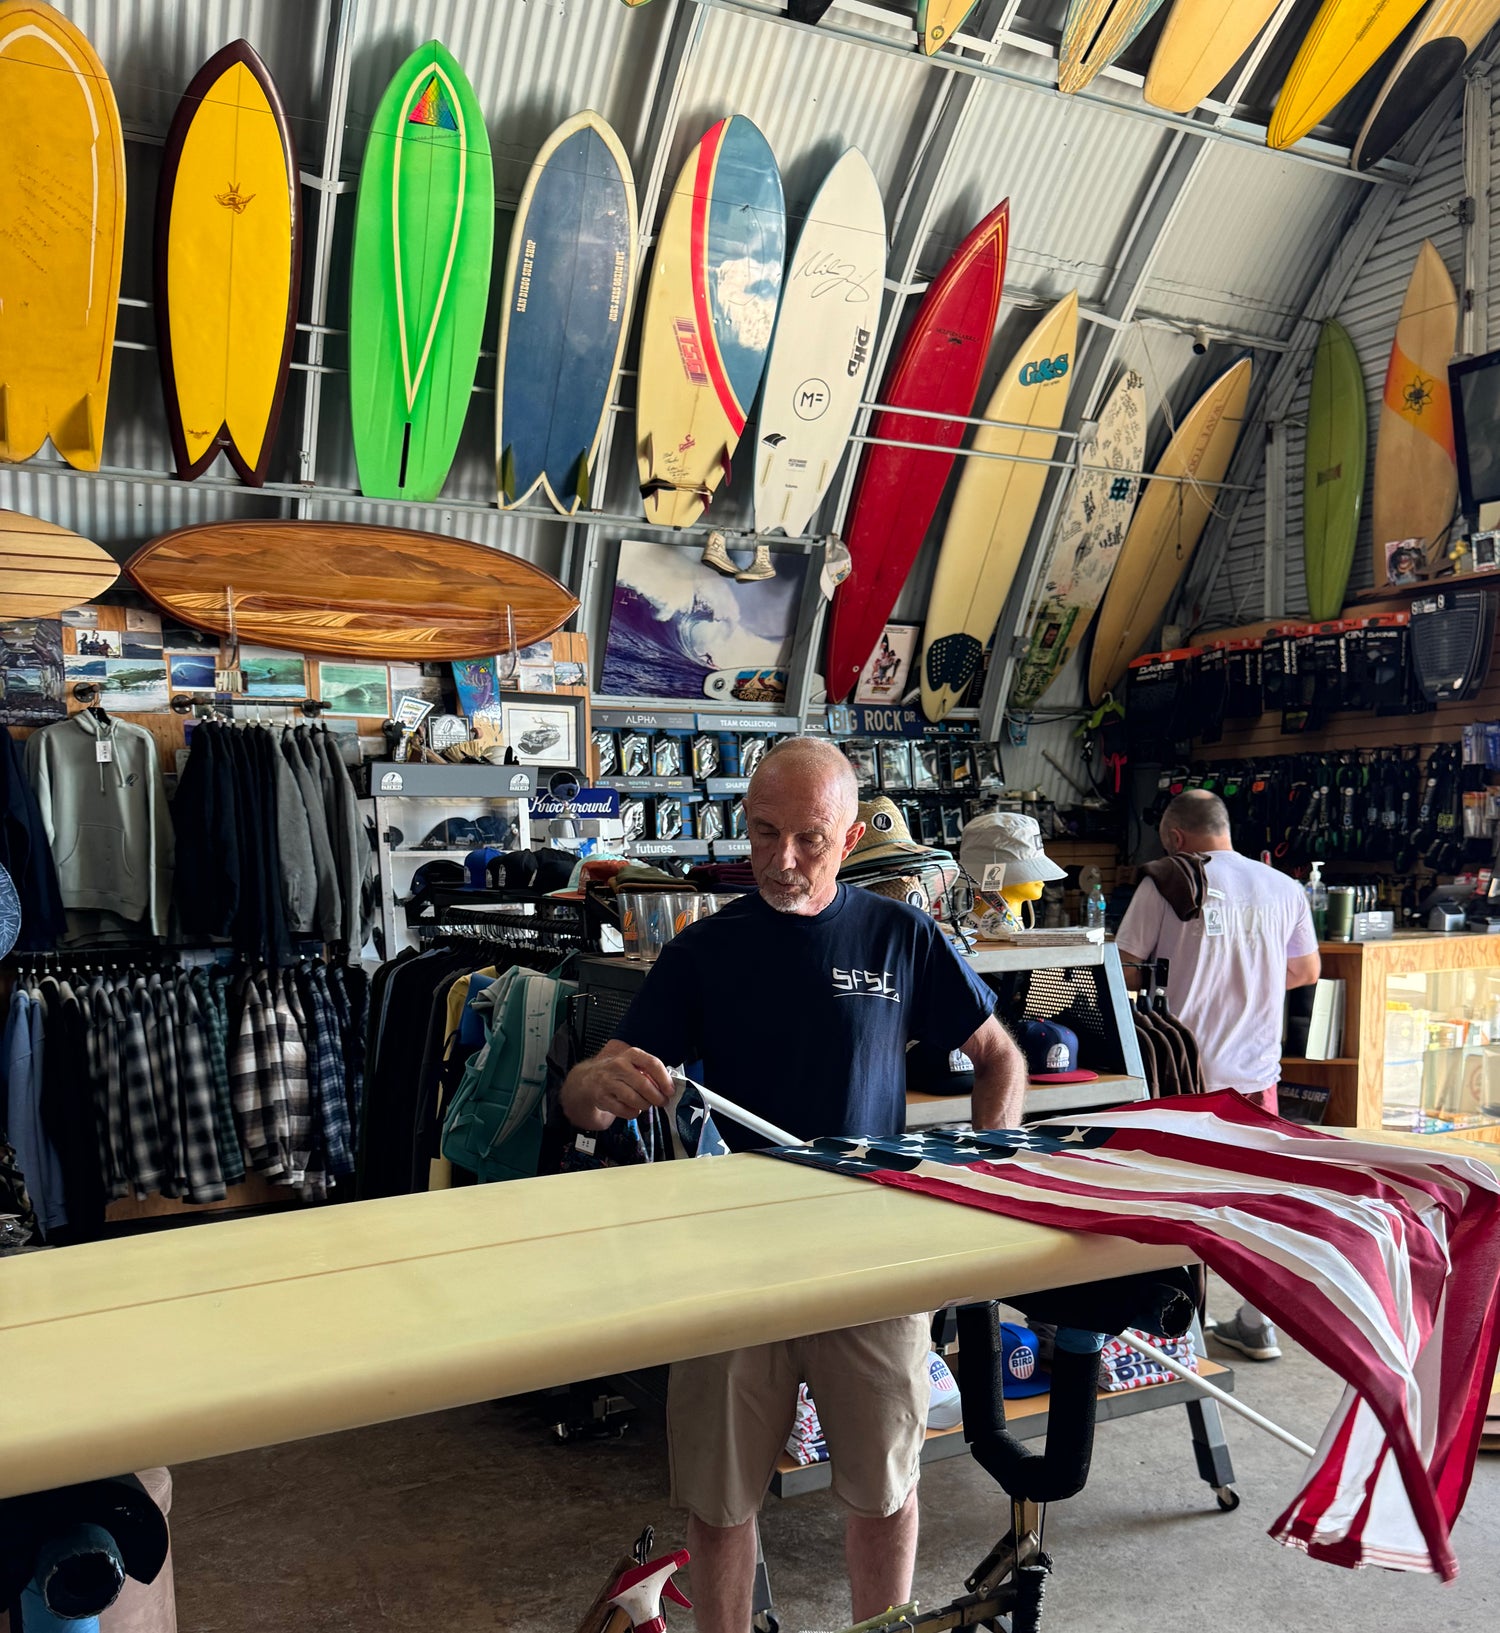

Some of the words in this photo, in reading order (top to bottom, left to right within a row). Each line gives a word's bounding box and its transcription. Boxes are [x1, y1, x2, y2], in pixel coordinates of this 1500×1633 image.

[525, 240, 536, 258] SHOP
[615, 251, 625, 266] SAN
[522, 258, 533, 277] SURF
[612, 265, 624, 287] DIEGO
[518, 277, 530, 298] DIEGO
[610, 286, 621, 305] SURF
[516, 297, 527, 312] SAN
[1018, 353, 1069, 386] G&S
[1138, 662, 1174, 675] DAKINE
[625, 715, 657, 724] ALPHA
[720, 719, 738, 728] TEAM
[739, 720, 777, 728] COLLECTION
[833, 710, 858, 732] BIG
[865, 710, 903, 732] ROCK
[905, 712, 921, 724] DR.
[635, 843, 676, 854] futures.
[1302, 1090, 1328, 1102] SURF
[1012, 1356, 1033, 1368] BIRD
